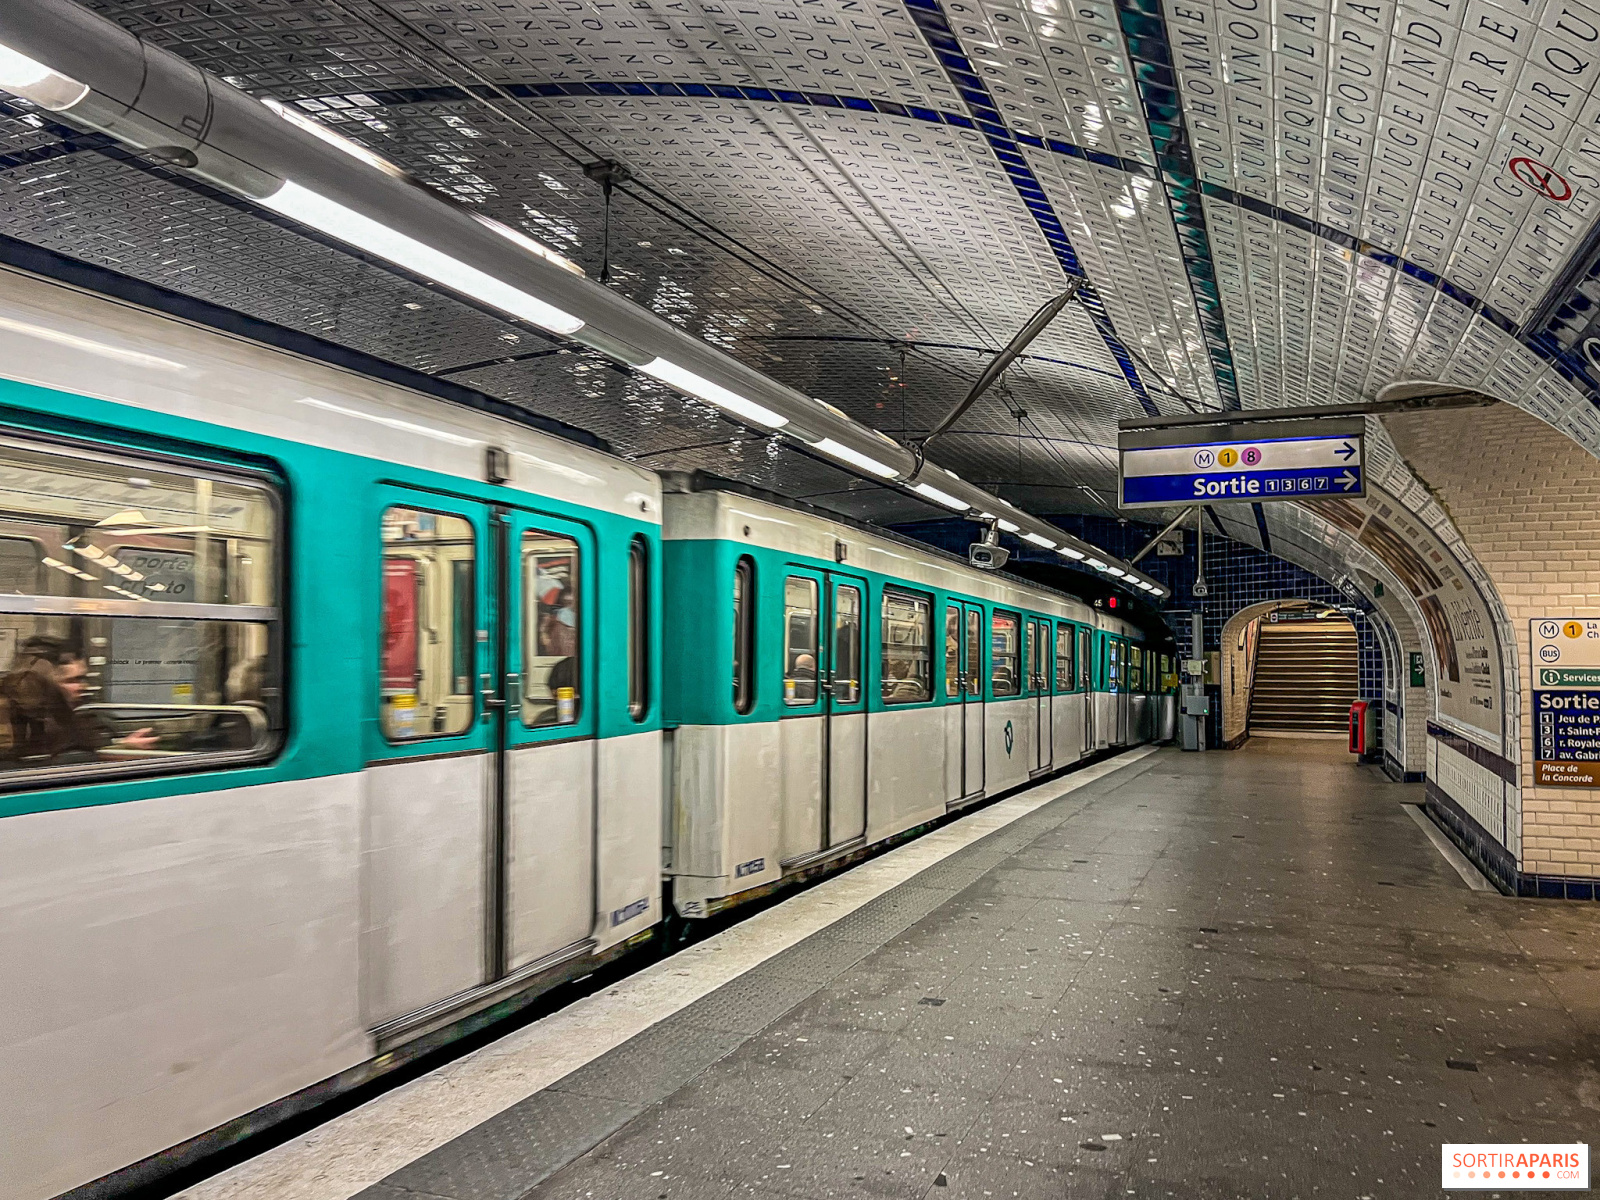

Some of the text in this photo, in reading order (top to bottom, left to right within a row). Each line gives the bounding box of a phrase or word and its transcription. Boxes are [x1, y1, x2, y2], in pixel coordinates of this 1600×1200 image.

[1193, 475, 1260, 496] Sortie
[1586, 622, 1598, 630] La
[1542, 650, 1558, 658] BUS
[1540, 693, 1599, 709] Sortie
[1558, 714, 1576, 723] Jeu
[1577, 714, 1591, 724] de
[1558, 727, 1566, 735] r.
[1559, 752, 1573, 760] av.
[1541, 763, 1579, 773] Place de
[1541, 773, 1593, 783] la Concorde
